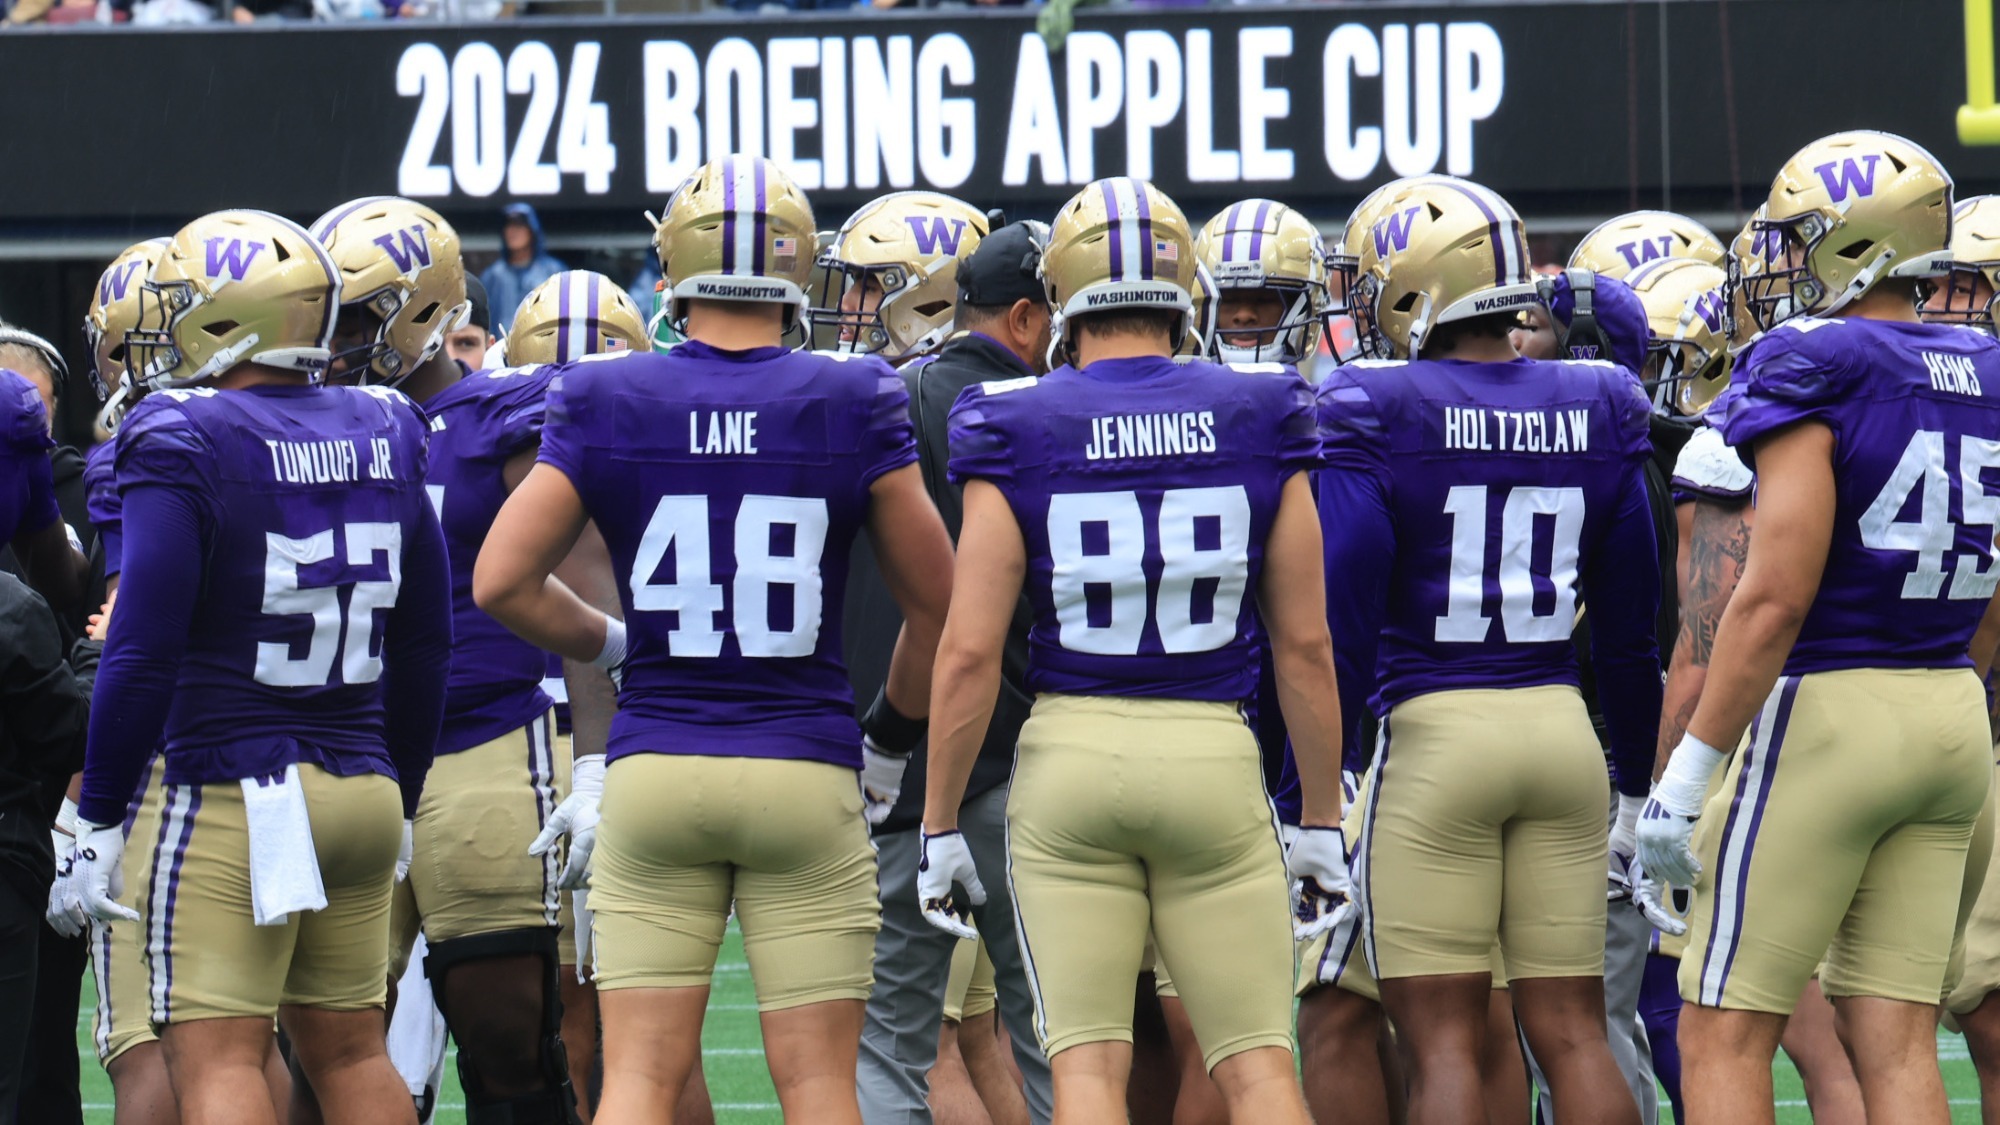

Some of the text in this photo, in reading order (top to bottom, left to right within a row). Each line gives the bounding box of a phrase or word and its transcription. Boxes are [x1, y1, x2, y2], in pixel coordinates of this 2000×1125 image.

[396, 22, 1504, 197] 2024 BOEING APPLE CUP
[1813, 154, 1881, 203] W
[373, 224, 434, 274] W
[904, 215, 966, 257] W
[1372, 206, 1420, 260] W
[99, 259, 143, 308] W
[204, 236, 266, 283] W
[697, 282, 787, 298] WASHINGTON
[1087, 290, 1178, 306] WASHINGTON
[1920, 351, 1982, 397] HEIMS
[689, 411, 759, 456] LANE
[1085, 410, 1217, 461] JENNINGS
[1445, 406, 1589, 453] HOLTZCLAW
[265, 437, 395, 484] TUNUUFI JR
[1858, 429, 2000, 600] 45
[629, 494, 830, 659] 48
[1046, 484, 1251, 656] 88
[1434, 484, 1586, 643] 10
[253, 521, 402, 687] 52
